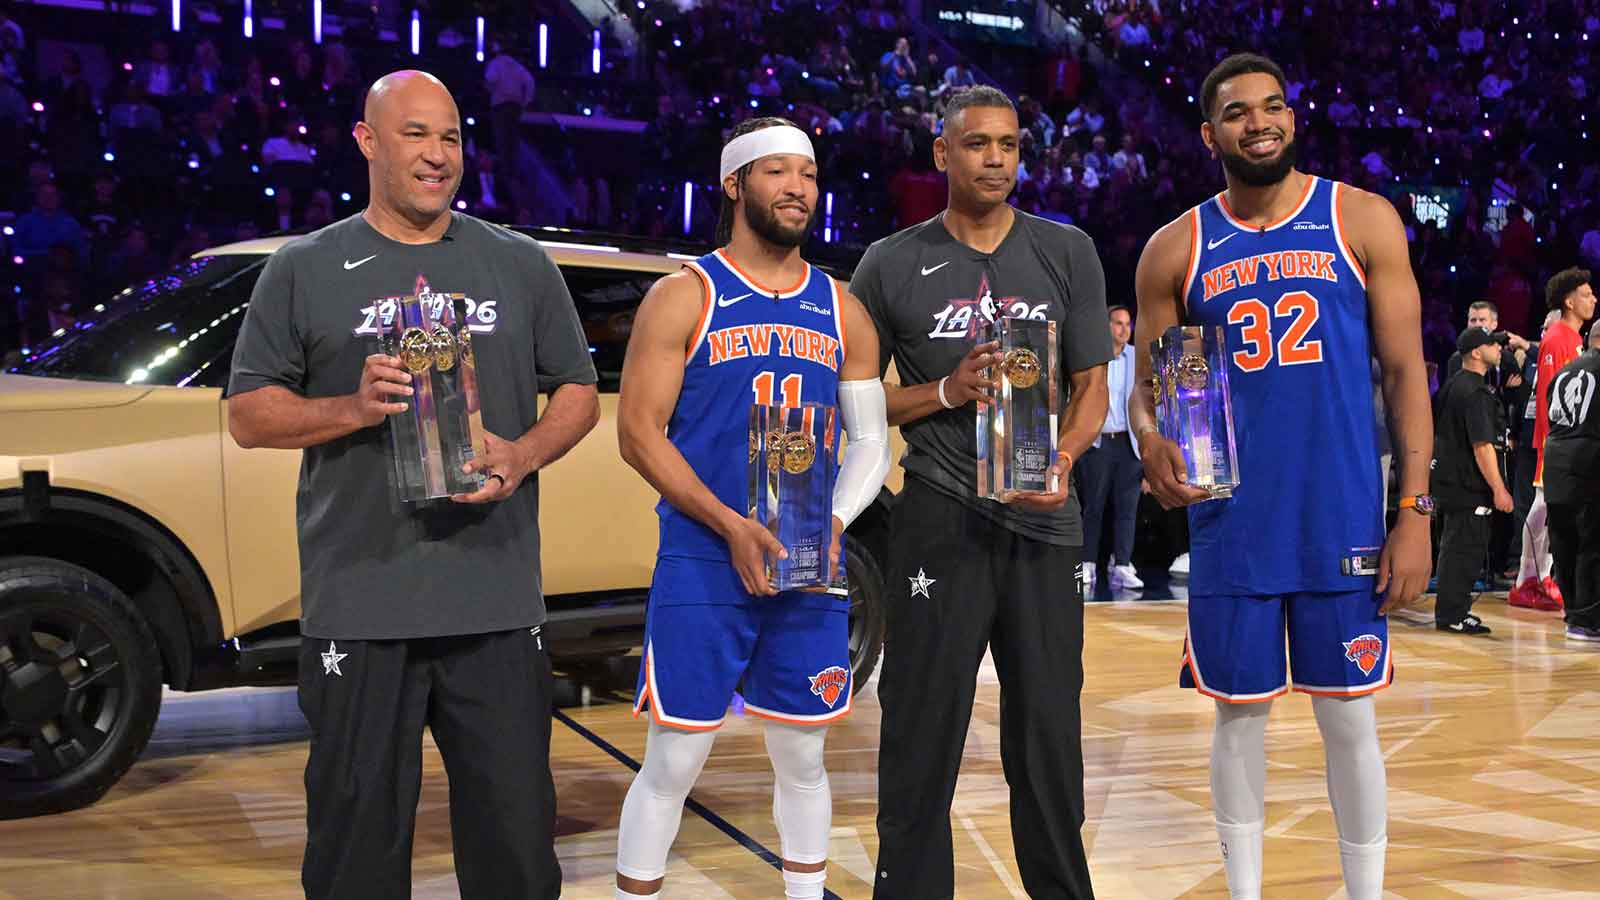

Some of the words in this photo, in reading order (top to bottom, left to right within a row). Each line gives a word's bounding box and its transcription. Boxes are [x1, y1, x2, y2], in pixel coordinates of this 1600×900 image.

[1201, 257, 1260, 303] NEW
[1261, 250, 1338, 283] YORK
[928, 304, 974, 339] LA
[1227, 290, 1323, 373] 32
[707, 323, 773, 367] NEW
[774, 323, 839, 373] YORK
[752, 371, 803, 408] 11
